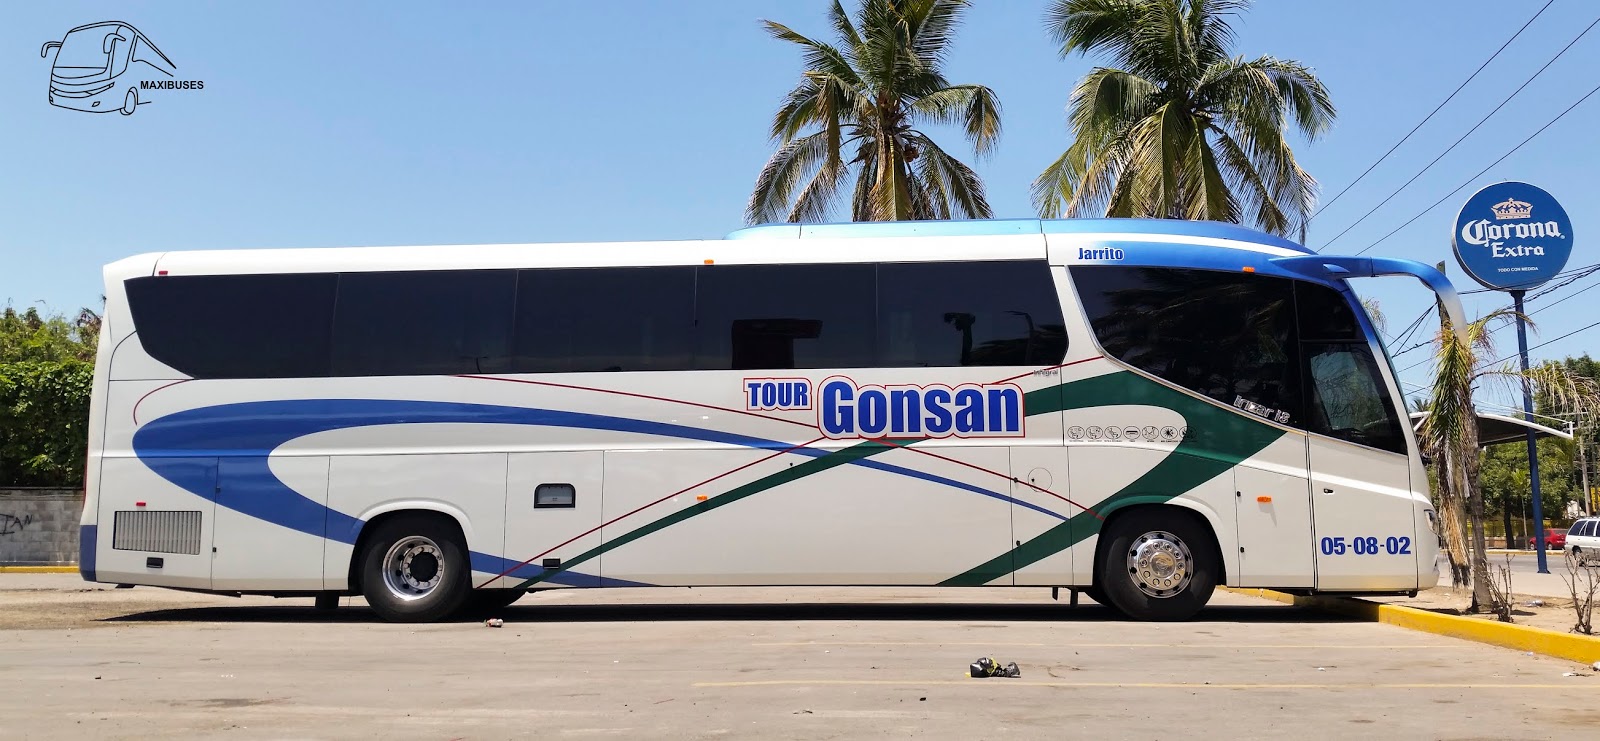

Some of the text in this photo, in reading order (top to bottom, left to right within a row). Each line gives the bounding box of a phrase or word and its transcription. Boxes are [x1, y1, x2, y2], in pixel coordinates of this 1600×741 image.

[1461, 218, 1562, 247] Corona
[1078, 247, 1124, 260] Jarrito
[1491, 241, 1545, 258] Extra
[747, 380, 1020, 434] TOUR Gonsan
[1321, 536, 1412, 556] 05-08-02
